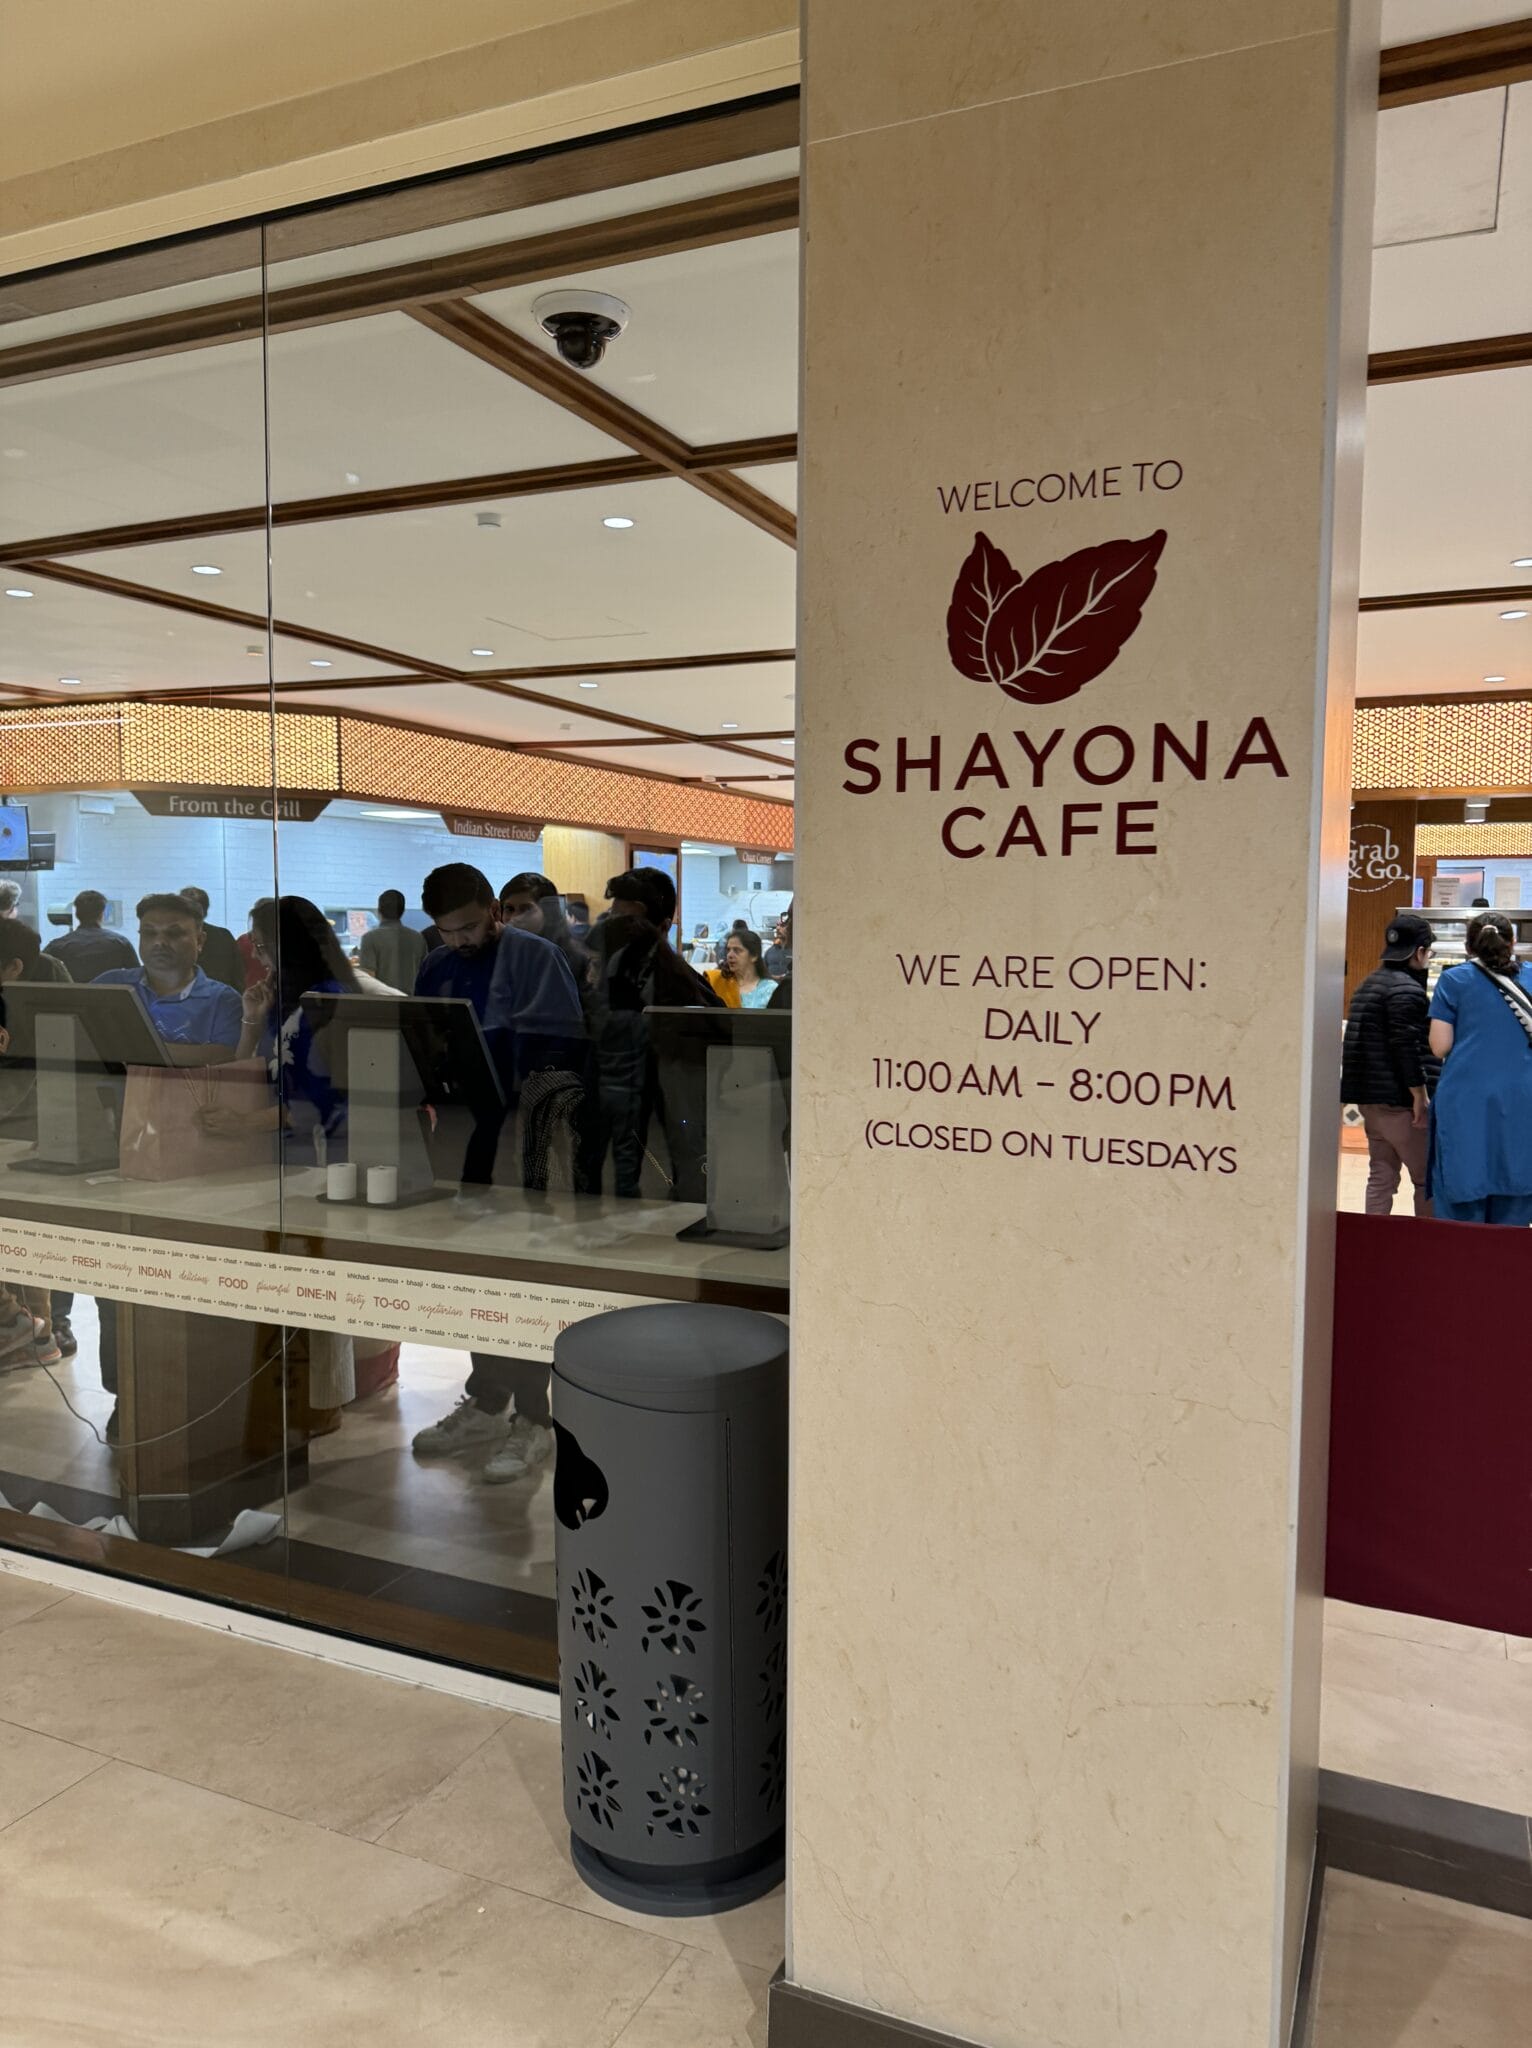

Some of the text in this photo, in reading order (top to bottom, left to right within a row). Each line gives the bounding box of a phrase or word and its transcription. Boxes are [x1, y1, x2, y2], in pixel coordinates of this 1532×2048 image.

[937, 460, 1183, 514] WELCOME TO
[842, 716, 1289, 795] SHAYONA
[169, 796, 300, 818] From the Grill
[454, 819, 536, 840] Indian Street Foods
[942, 800, 1158, 859] CAFE
[1367, 860, 1401, 879] Go
[896, 953, 1208, 991] WE ARE OPEN:
[985, 1008, 1101, 1044] DAILY
[1069, 1068, 1159, 1105] 8:00
[1170, 1074, 1236, 1110] PM
[865, 1120, 1238, 1174] (CLOSED ON TUESDAYS
[0, 1245, 27, 1257] TO-GO
[72, 1256, 101, 1268] FRESH
[139, 1266, 171, 1279] INDIAN
[219, 1277, 248, 1290] FOOD
[297, 1287, 336, 1301] DINE-IN
[346, 1293, 366, 1310] tasty
[374, 1297, 410, 1311] TO-GO
[417, 1303, 463, 1319] vegetarian
[471, 1309, 508, 1324] FRESH
[515, 1315, 551, 1333] crunchy
[453, 1286, 476, 1294] chutney
[551, 1297, 569, 1305] panini
[578, 1300, 594, 1308] pizza
[218, 1300, 237, 1308] chutney
[425, 1328, 445, 1336] masala
[518, 1340, 532, 1348] juice
